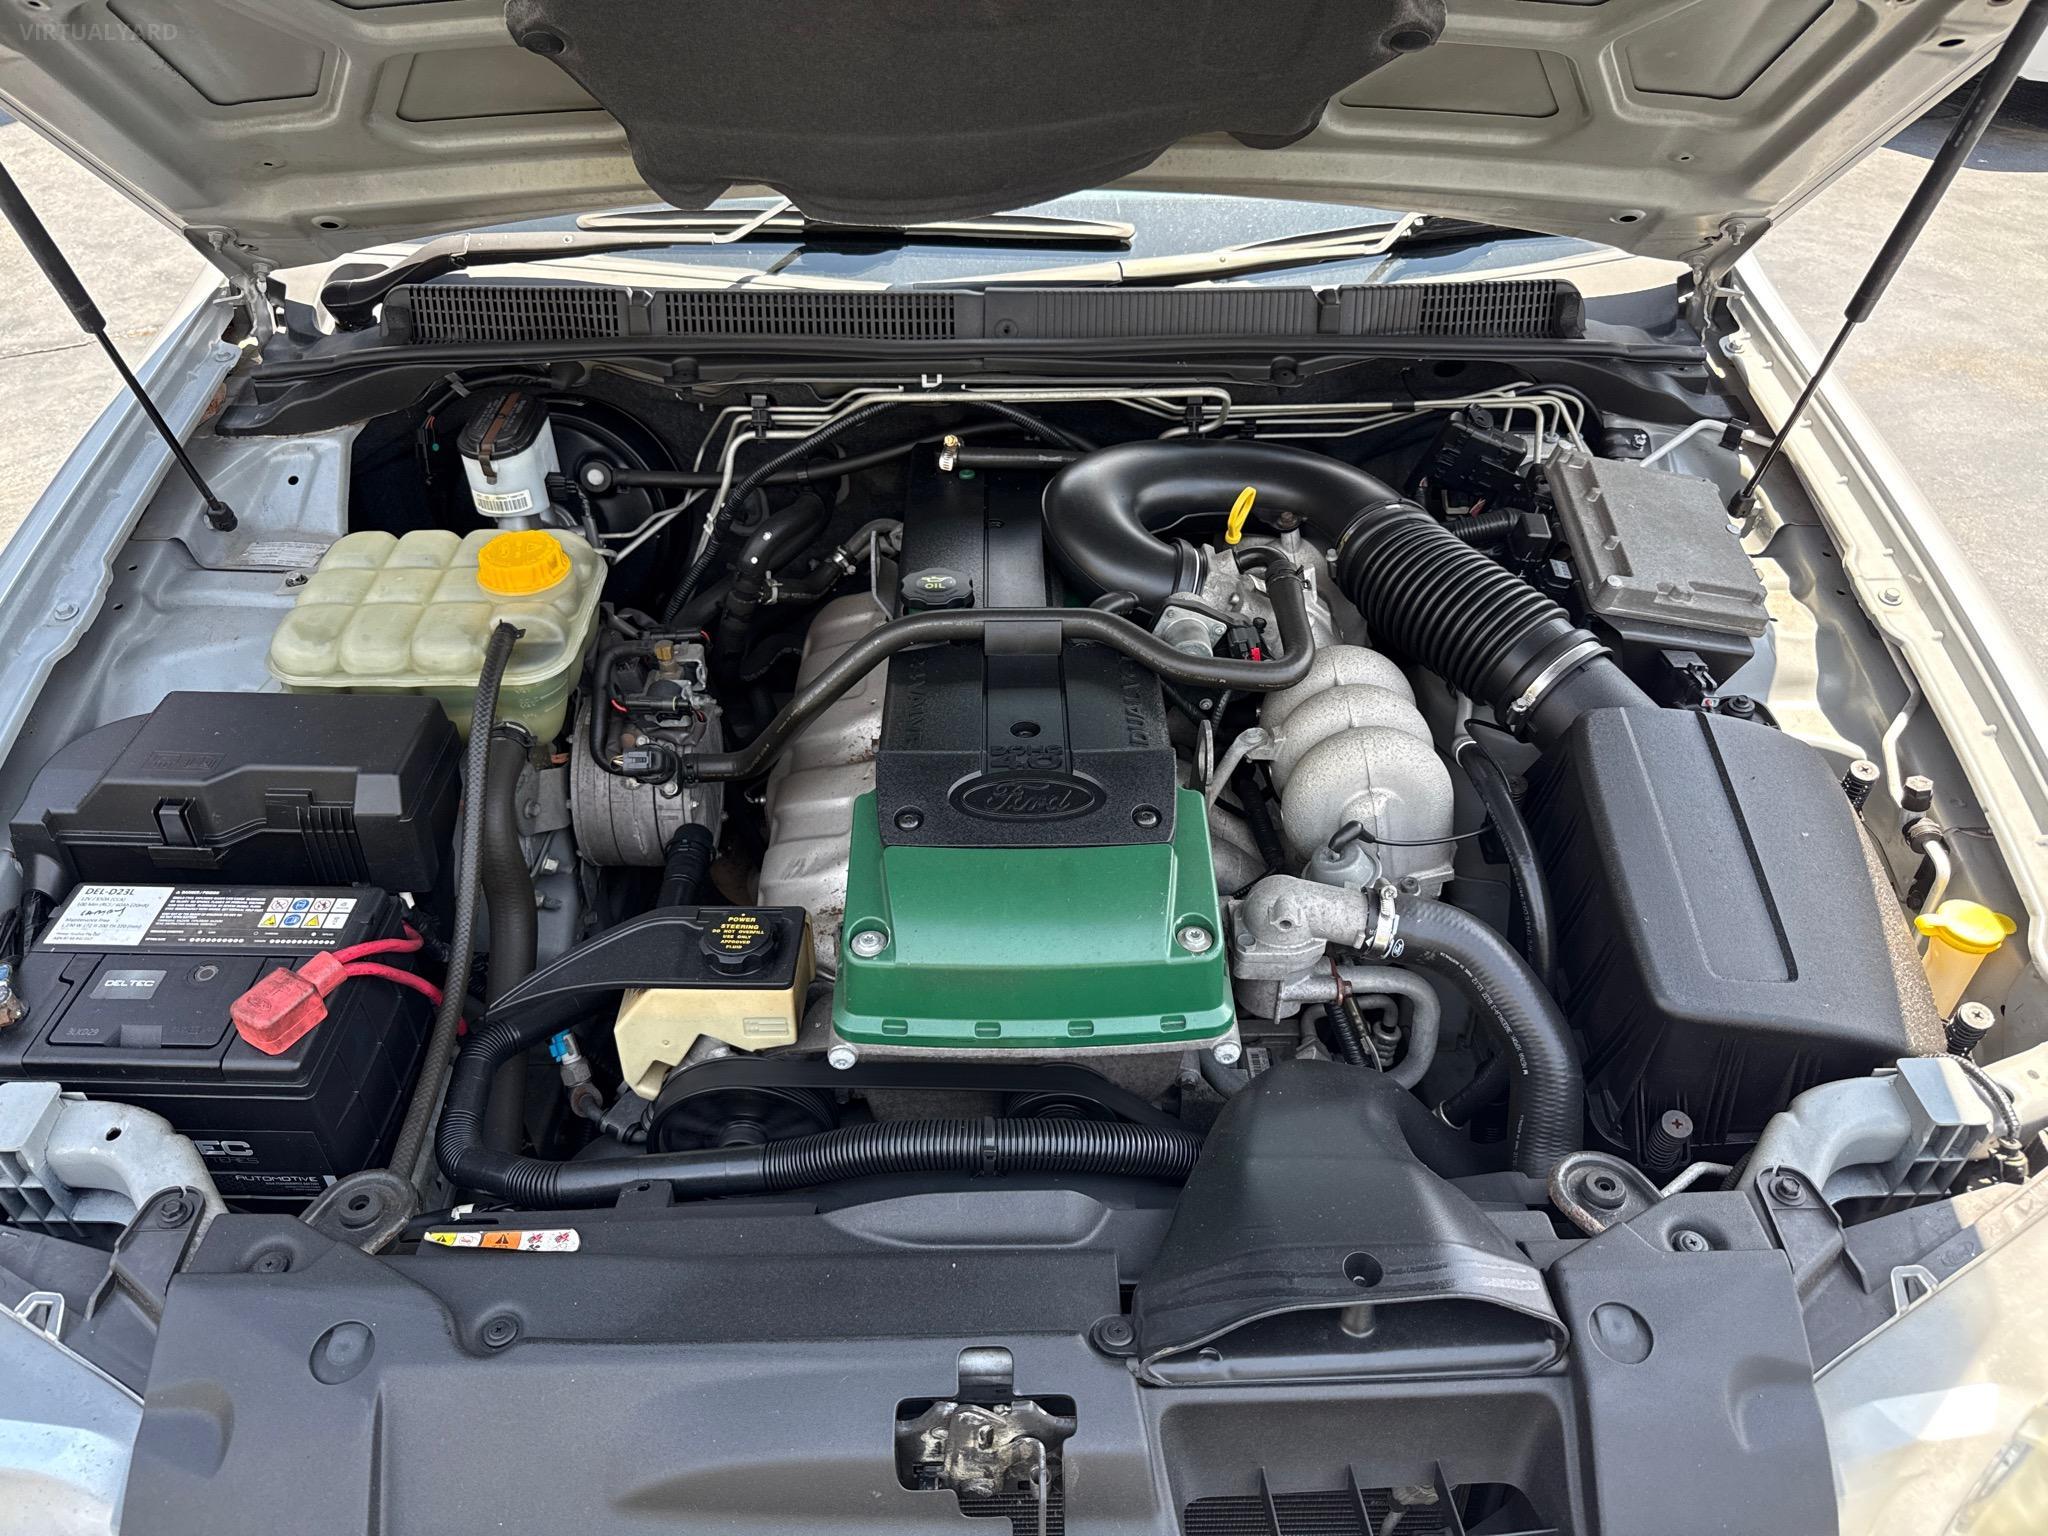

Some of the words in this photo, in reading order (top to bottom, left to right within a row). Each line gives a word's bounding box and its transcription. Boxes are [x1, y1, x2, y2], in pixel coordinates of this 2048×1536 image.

[985, 783, 1073, 813] Ford
[85, 888, 135, 896] DEL-D23L
[1440, 951, 1460, 965] AUSTRALIA
[104, 979, 156, 987] DELTEC
[192, 1140, 254, 1156] EC
[234, 1174, 319, 1182] AUTOMOTIVE
